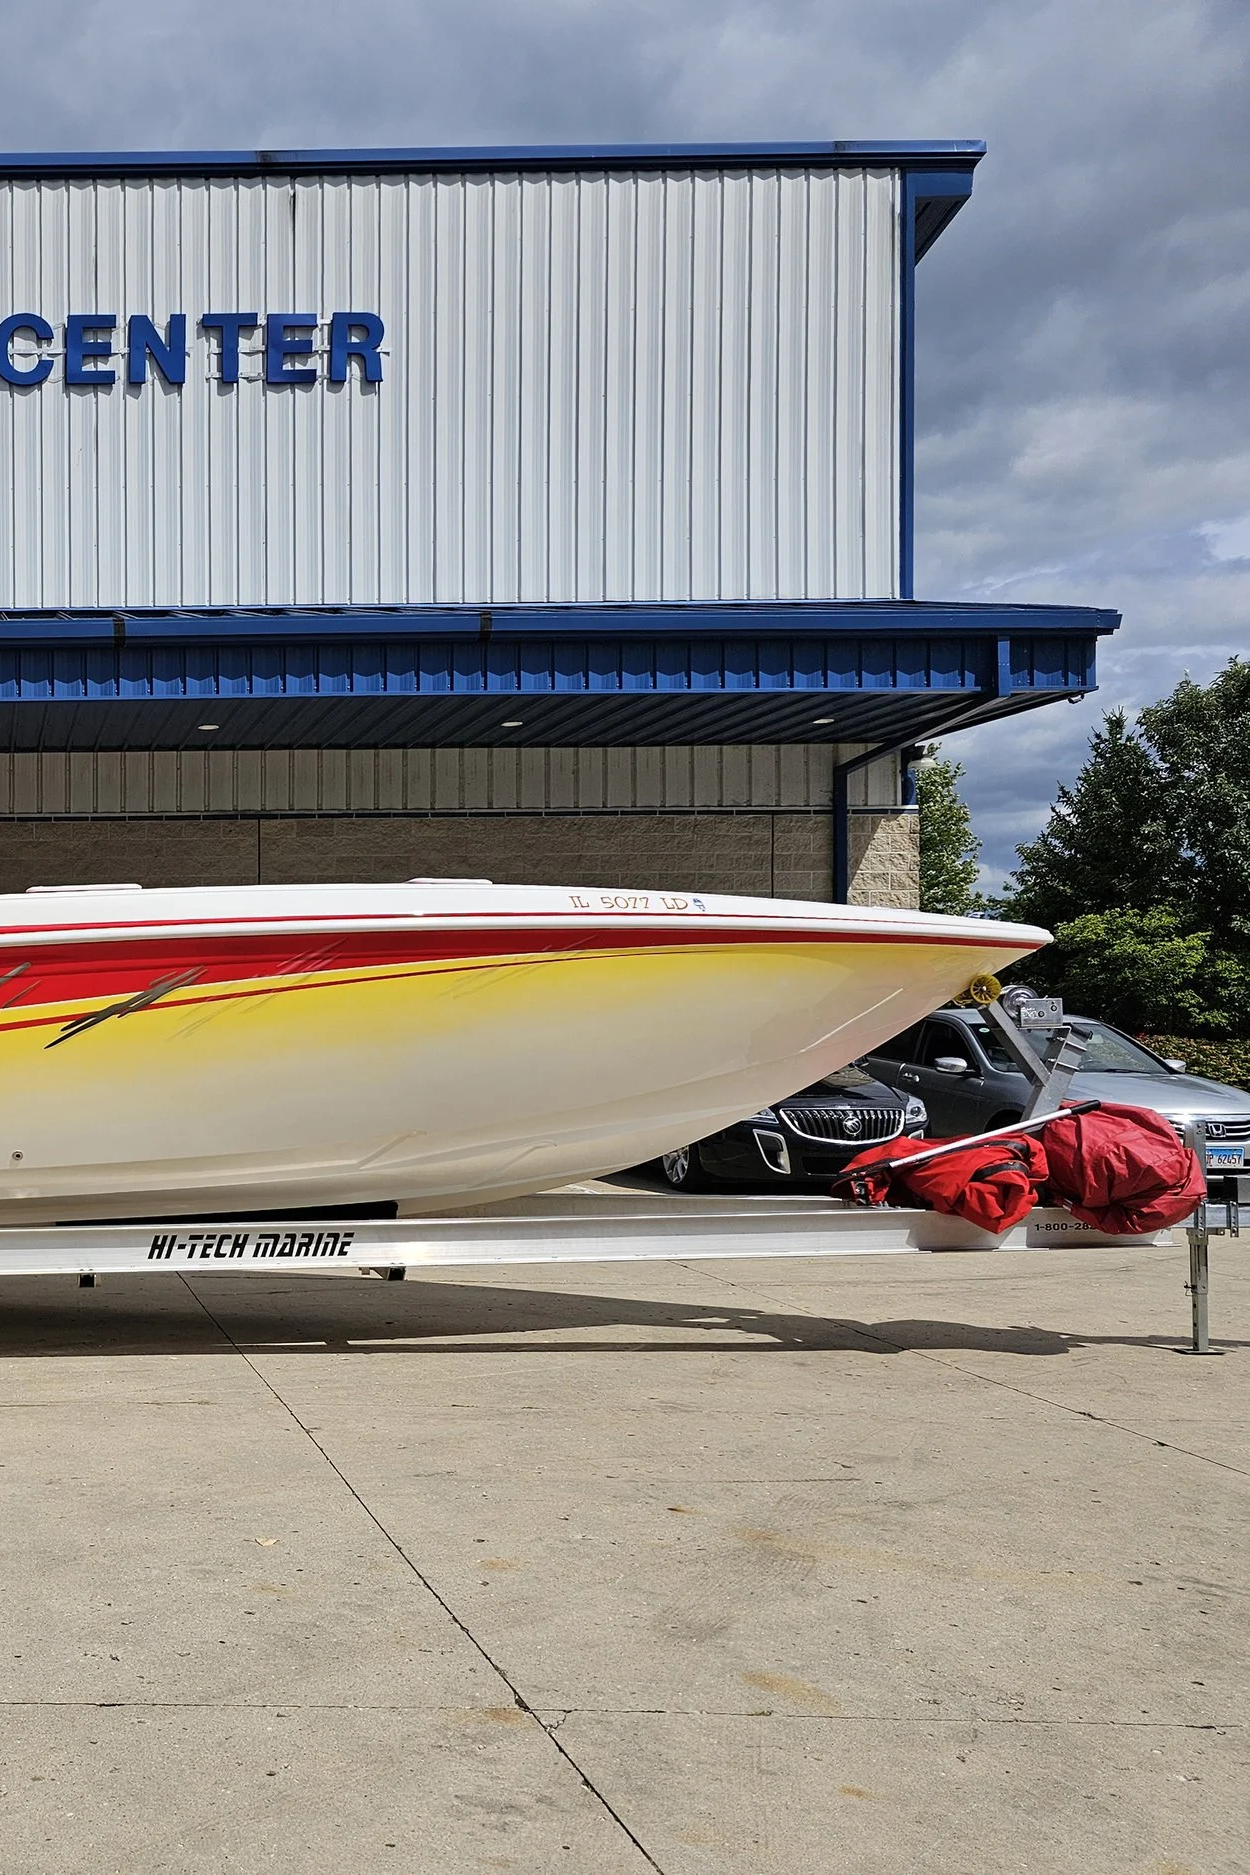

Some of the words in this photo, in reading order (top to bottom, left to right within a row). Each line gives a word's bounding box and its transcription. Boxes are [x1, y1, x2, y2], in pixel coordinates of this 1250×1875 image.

[569, 895, 590, 909] IL
[600, 896, 650, 909] 5077
[660, 897, 689, 910] LD
[147, 1233, 250, 1259] HI-TECH
[252, 1232, 355, 1258] MARINE
